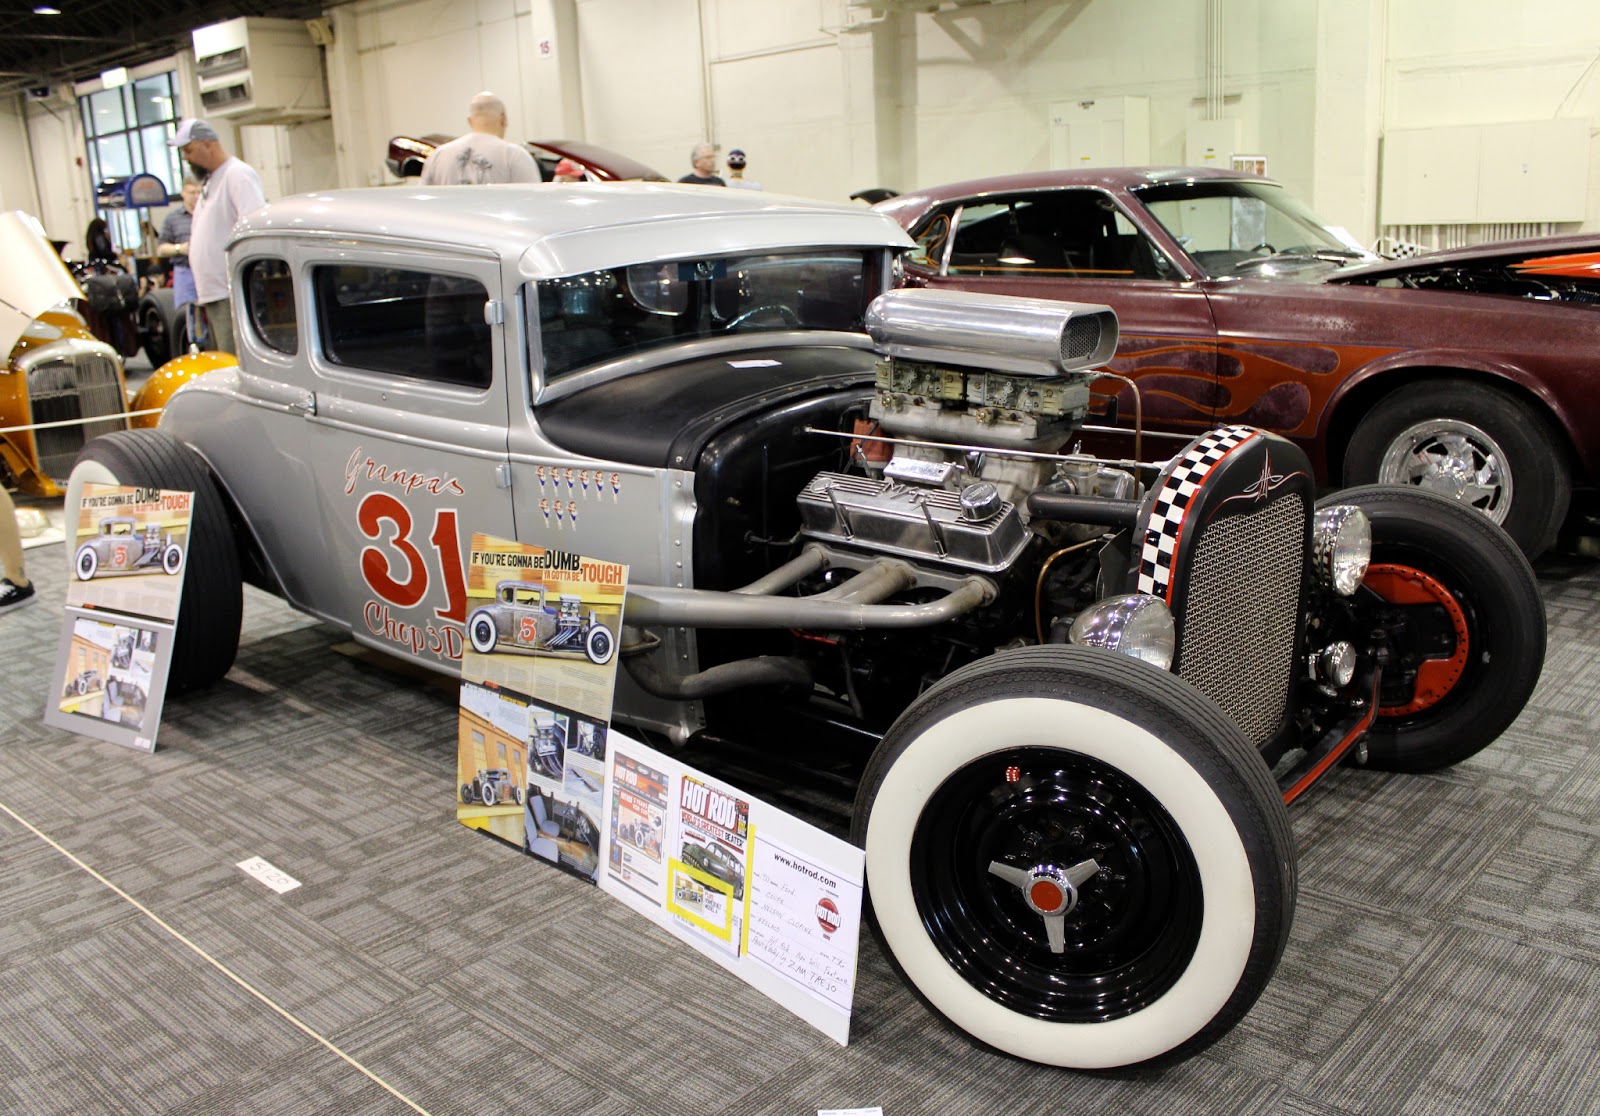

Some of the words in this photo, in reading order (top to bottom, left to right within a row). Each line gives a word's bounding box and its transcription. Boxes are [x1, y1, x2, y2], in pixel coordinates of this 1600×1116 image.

[161, 494, 190, 510] TOUGH
[356, 491, 469, 626] 31
[472, 552, 480, 564] IF
[480, 552, 506, 567] YOU'RE
[507, 554, 533, 569] GONNA
[533, 556, 545, 569] BE
[543, 569, 551, 580] YA
[551, 570, 571, 582] GOTTA
[571, 571, 580, 582] BE
[581, 563, 623, 585] TOUGH
[520, 617, 537, 642] 5
[681, 779, 710, 817] HOT
[707, 791, 737, 830] ROD
[681, 811, 701, 827] WORLD'S
[701, 820, 725, 839] GREATEST
[774, 853, 837, 889] www.hotrod.com
